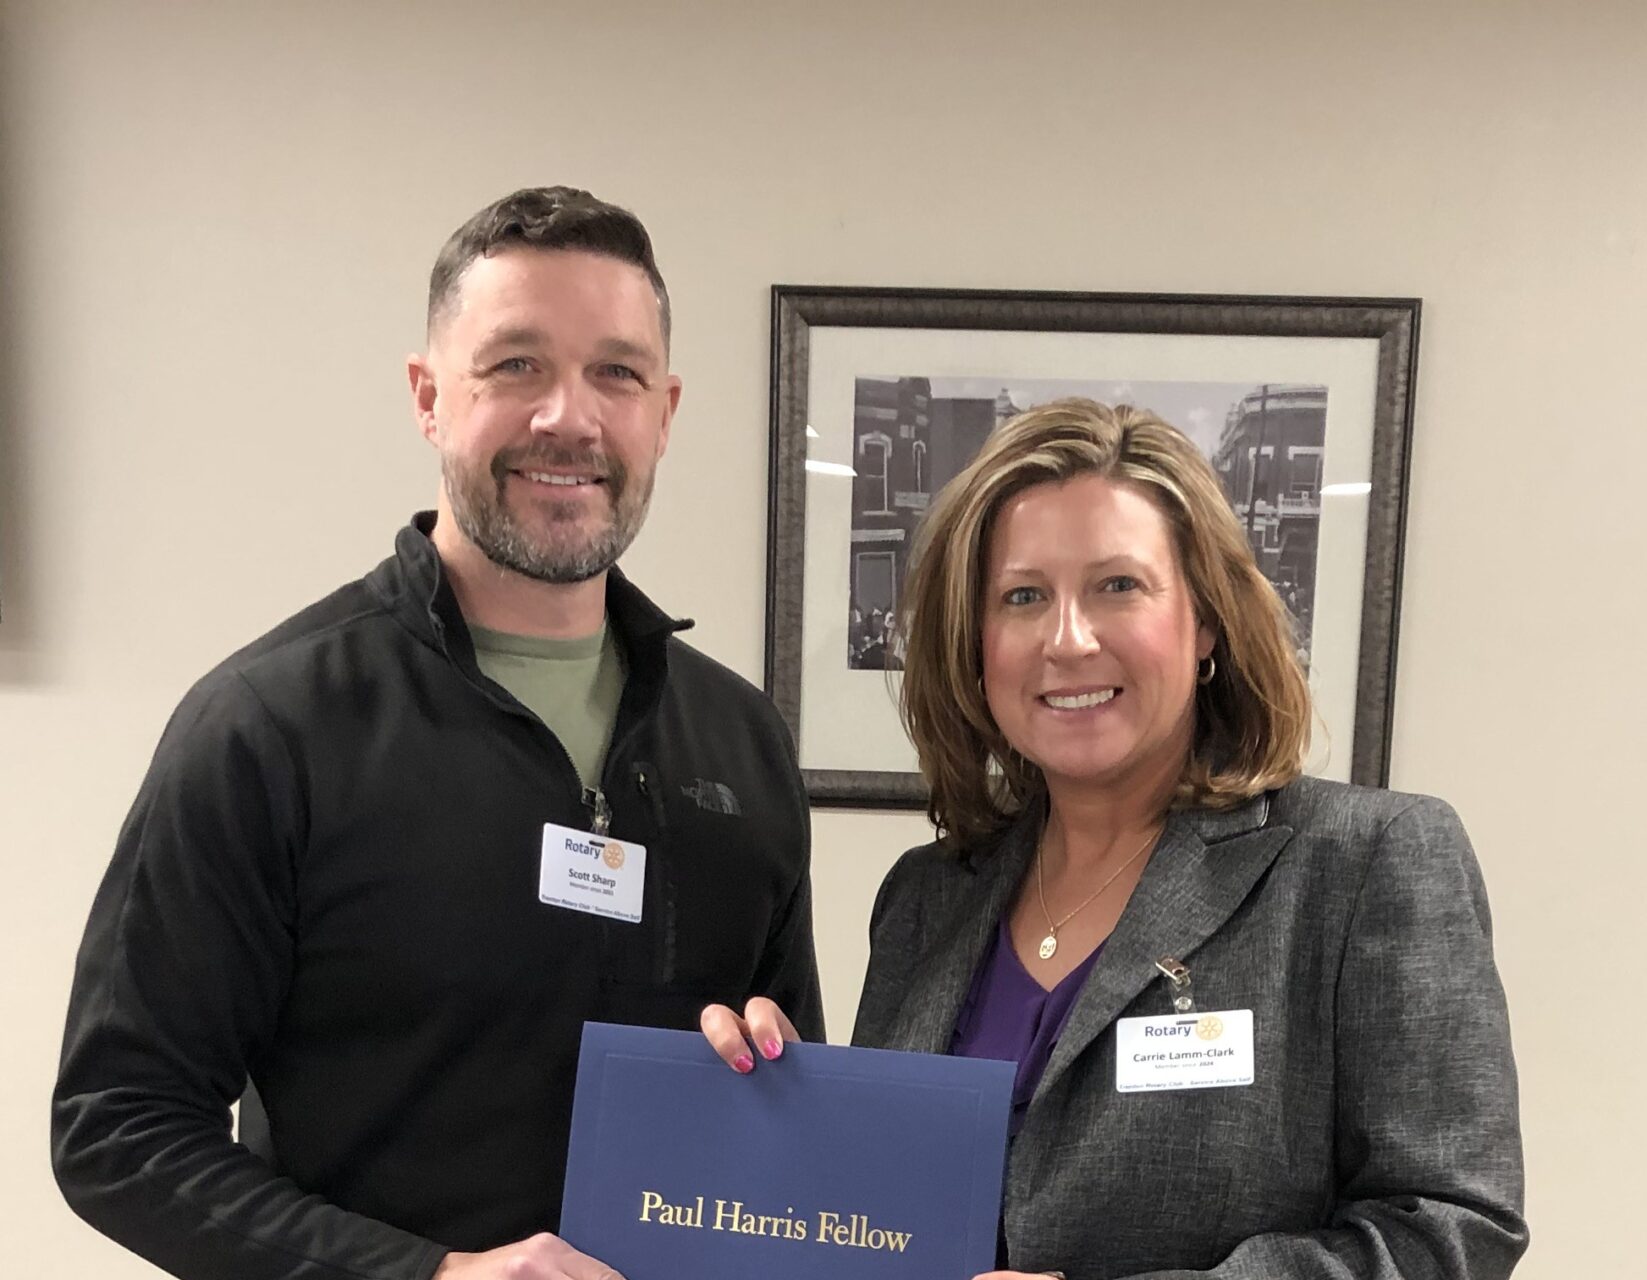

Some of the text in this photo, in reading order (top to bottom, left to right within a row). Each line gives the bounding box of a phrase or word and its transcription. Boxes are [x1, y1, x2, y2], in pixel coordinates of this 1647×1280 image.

[565, 838, 601, 859] Rotary
[568, 868, 616, 888] Scott Sharp
[1145, 1025, 1191, 1037] Rotary
[1133, 1048, 1235, 1062] Carrie Lamm-Clark
[639, 1191, 913, 1253] Paul Harris Fellow
